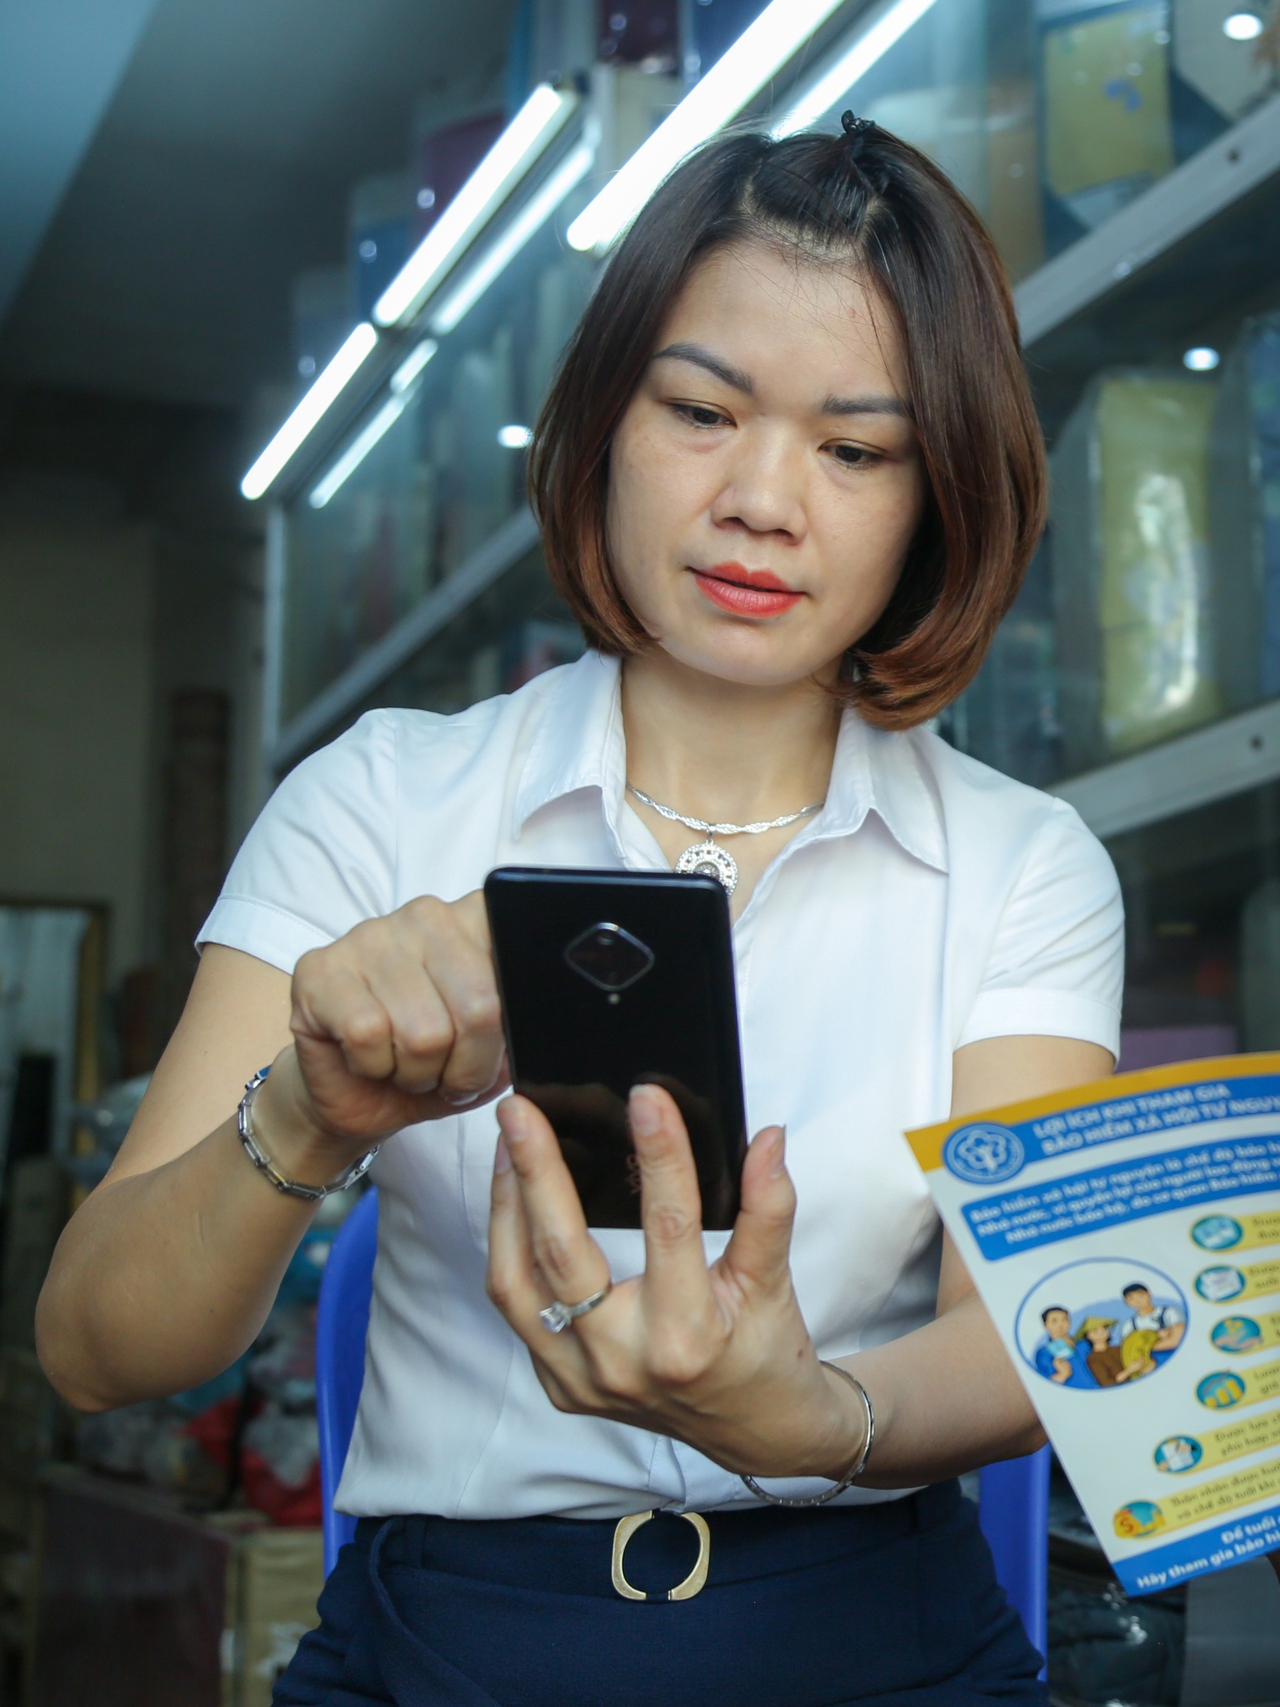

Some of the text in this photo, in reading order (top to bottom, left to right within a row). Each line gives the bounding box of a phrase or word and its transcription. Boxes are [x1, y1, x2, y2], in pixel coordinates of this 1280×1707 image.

[1032, 1083, 1231, 1139] LỢI ÍCH KHI THAM GIA
[1041, 1131, 1083, 1155] BẢO
[1083, 1120, 1134, 1145] HIỂM
[1133, 1113, 1162, 1132] XÃ
[1161, 1105, 1200, 1126] HỘI
[1199, 1101, 1227, 1118] TỰ
[1221, 1526, 1244, 1544] Để
[1246, 1516, 1277, 1538] tuổi
[1137, 1571, 1167, 1589] Hãy
[1168, 1557, 1209, 1577] tham
[1210, 1547, 1234, 1566] gia
[1235, 1536, 1265, 1555] bảo
